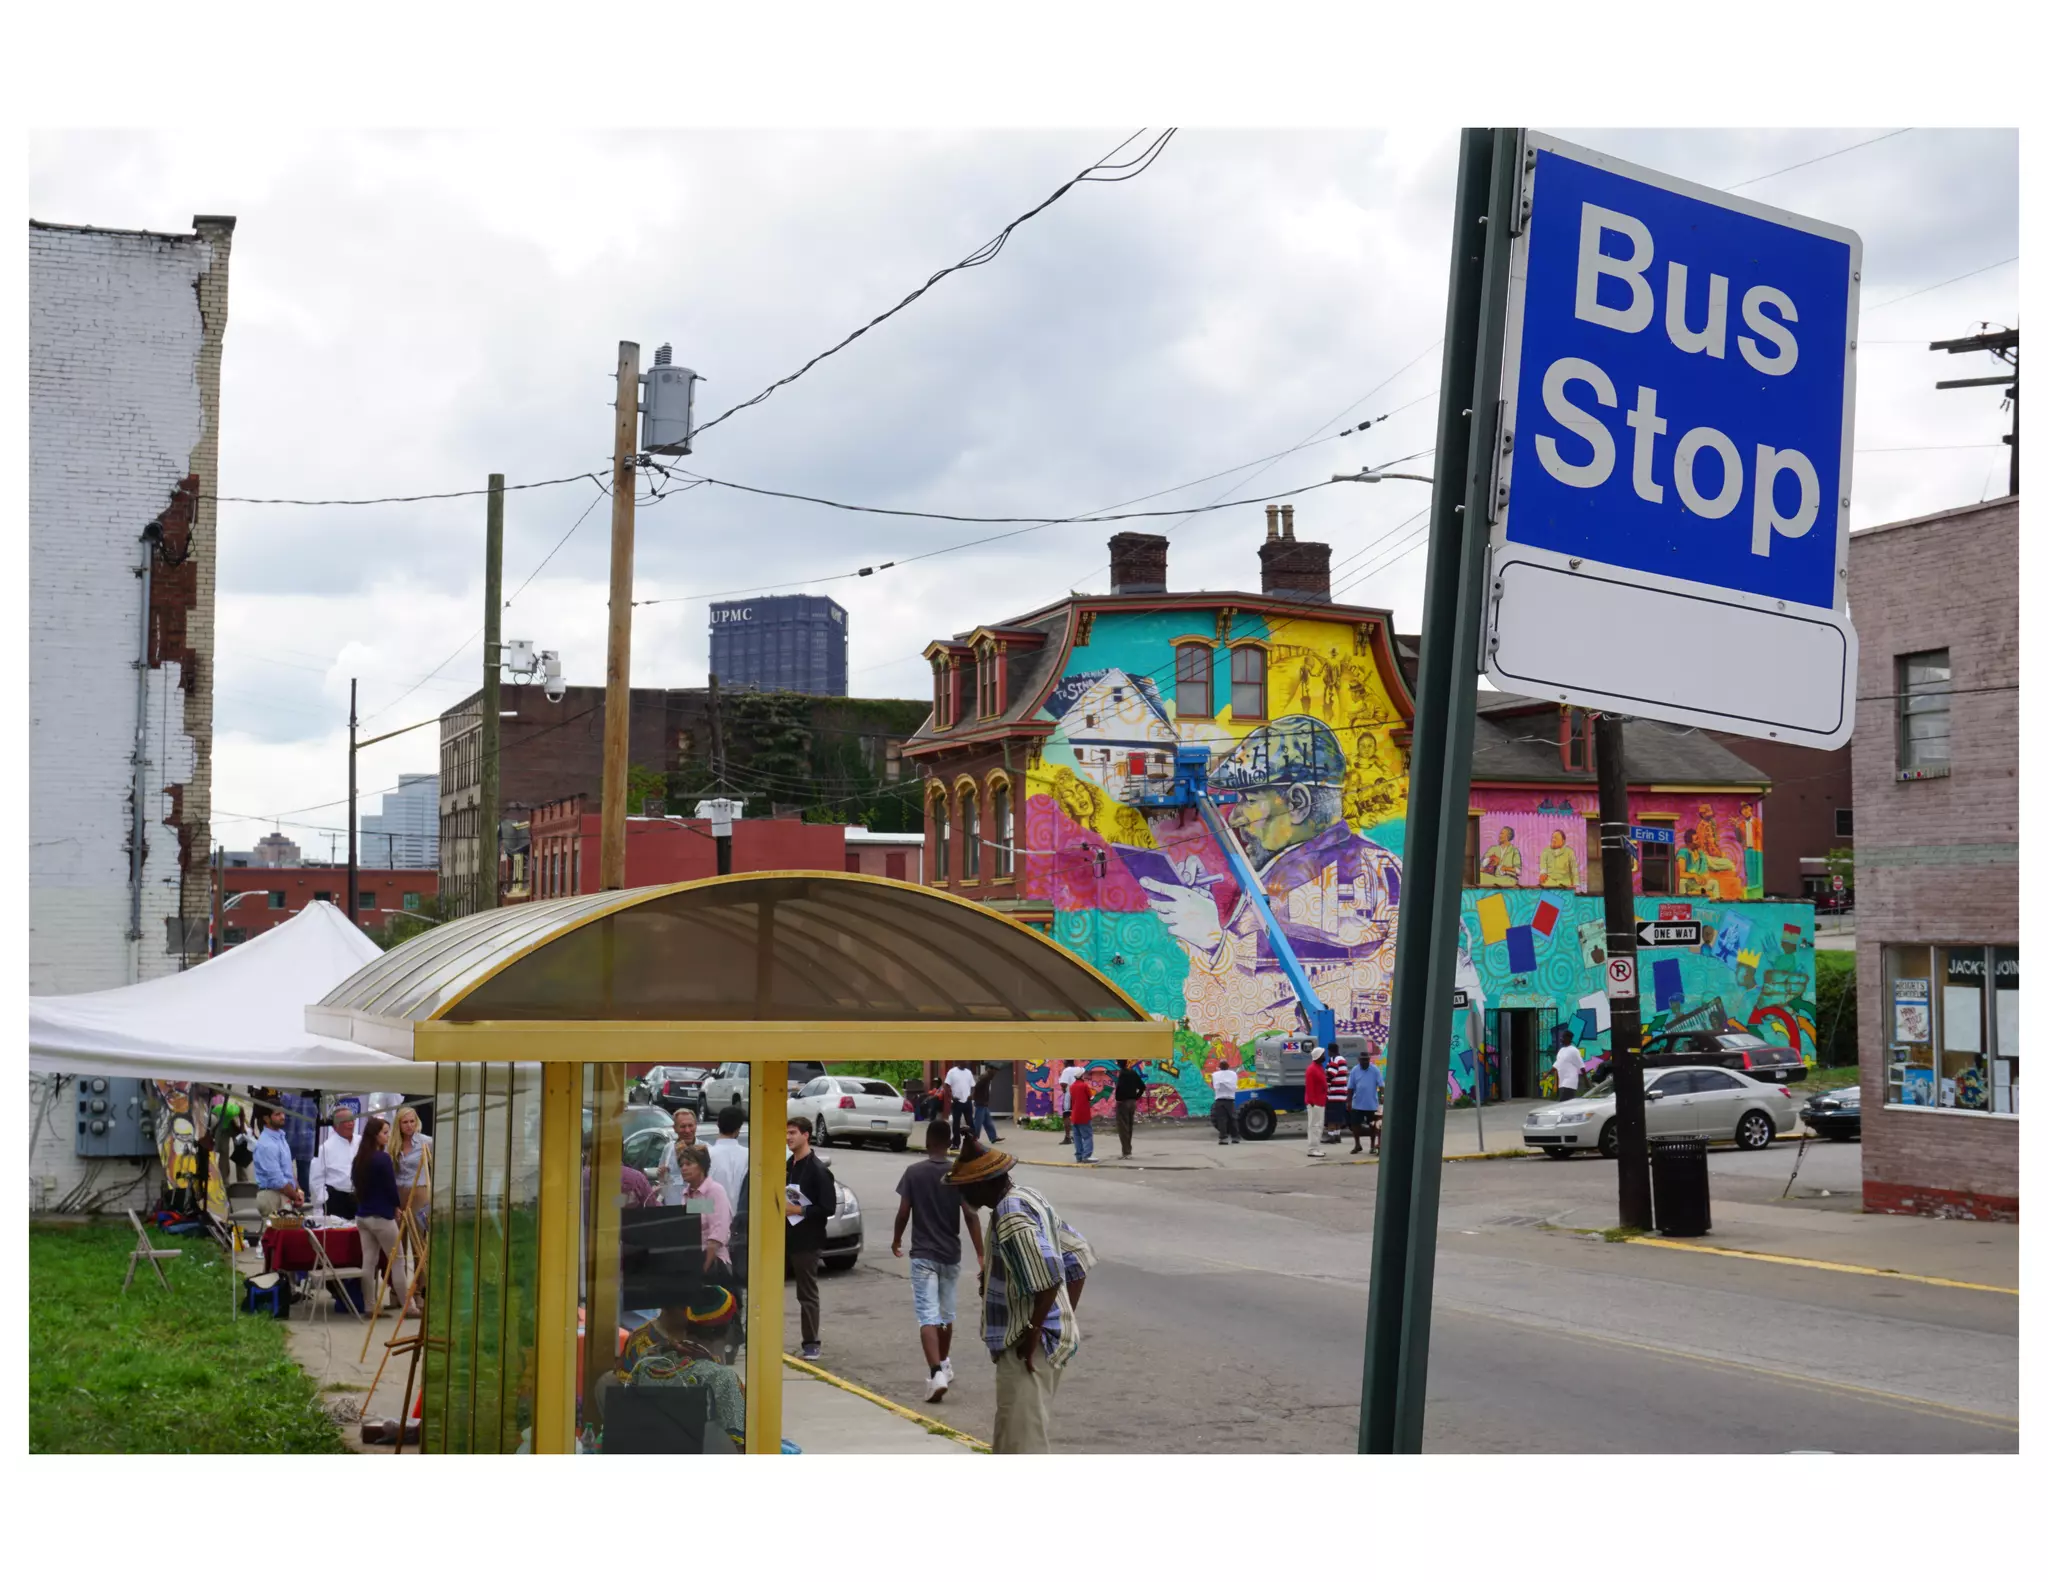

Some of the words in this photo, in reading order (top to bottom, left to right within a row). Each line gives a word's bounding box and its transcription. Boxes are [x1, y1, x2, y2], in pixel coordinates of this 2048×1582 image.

[1575, 201, 1799, 376] Bus
[1535, 356, 1821, 557] Stop
[711, 608, 752, 623] UPMC
[1635, 828, 1654, 840] Erin
[1658, 830, 1669, 842] St
[1654, 928, 1671, 938] ONE
[1675, 928, 1694, 938] WAY
